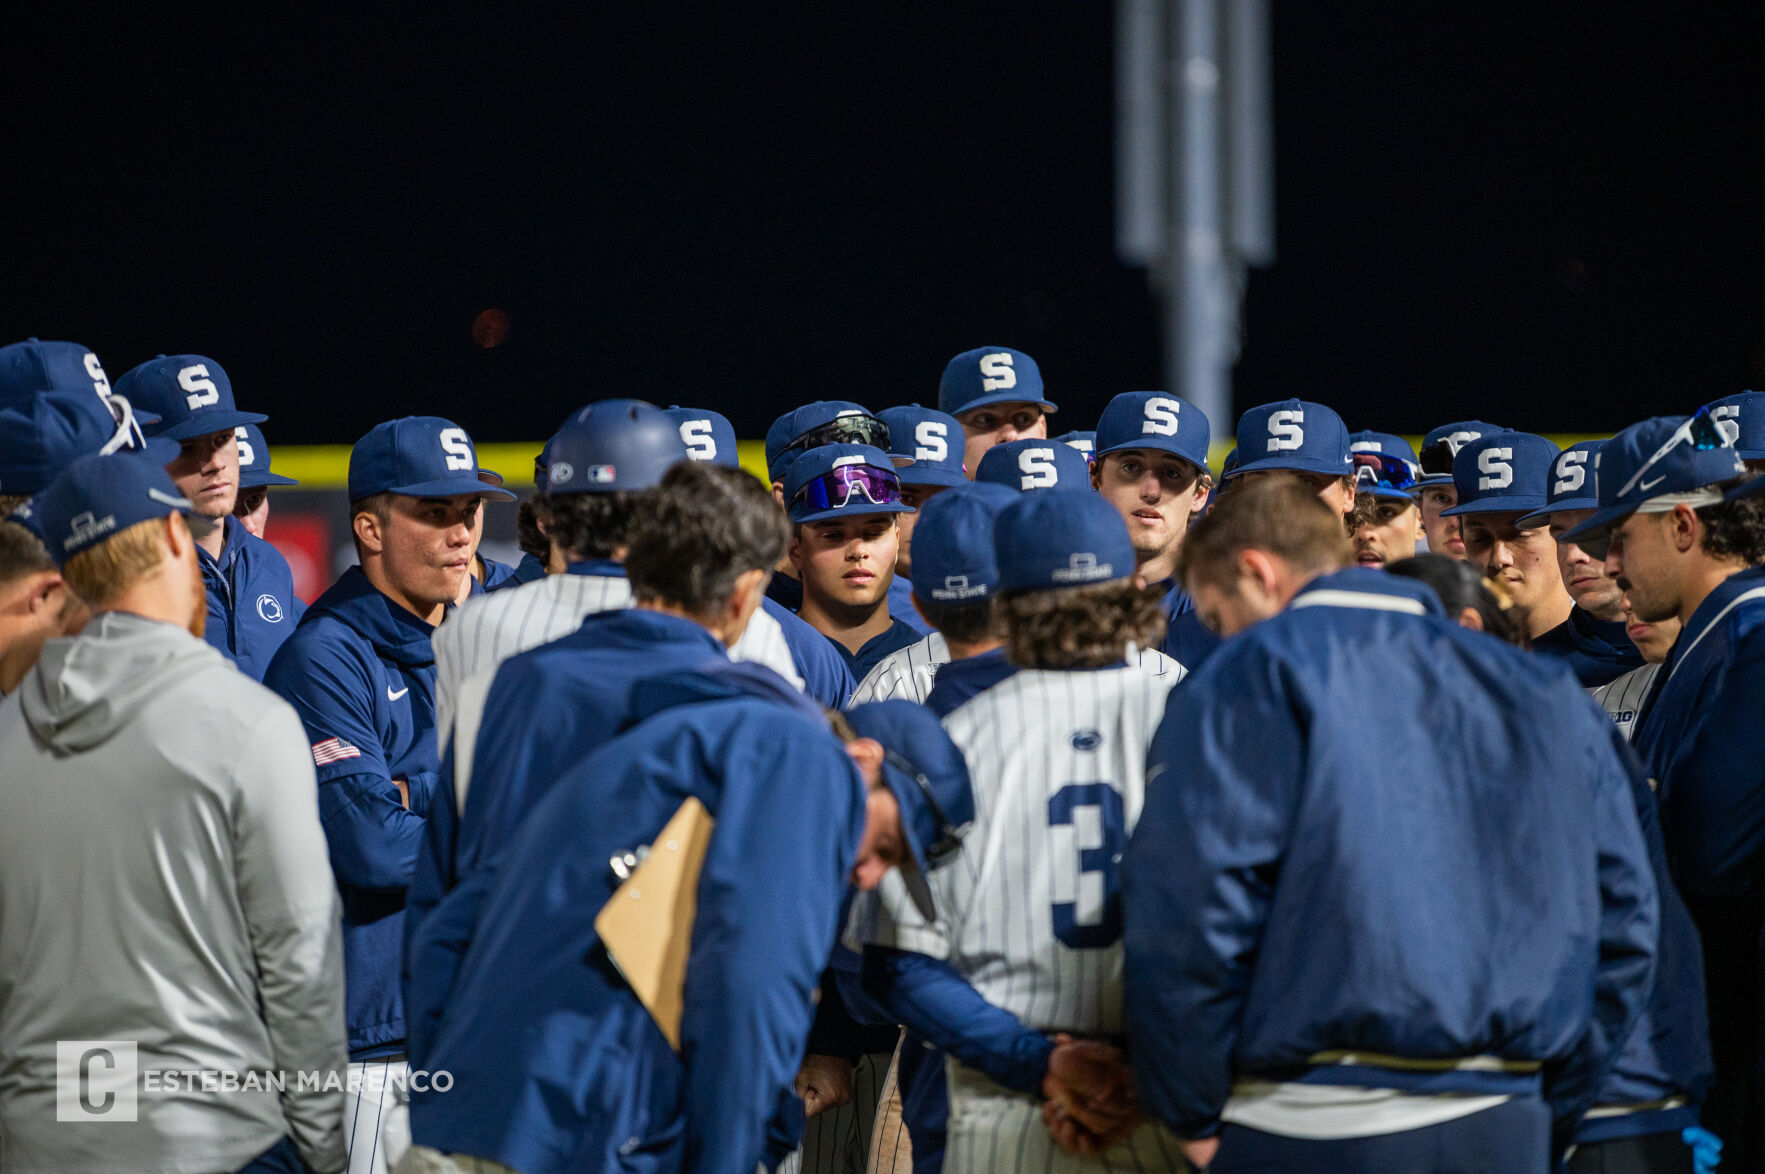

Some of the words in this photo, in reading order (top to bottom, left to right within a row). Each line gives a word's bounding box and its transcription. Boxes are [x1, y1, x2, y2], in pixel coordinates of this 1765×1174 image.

[83, 352, 113, 400] S
[177, 364, 220, 411] S
[979, 353, 1017, 391] S
[1142, 397, 1180, 437] S
[1267, 410, 1304, 452] S
[439, 427, 474, 471] S
[679, 420, 717, 461] S
[915, 421, 948, 462] S
[1018, 448, 1059, 490] S
[1478, 447, 1513, 490] S
[1554, 450, 1589, 495] S
[1048, 783, 1124, 949] 3
